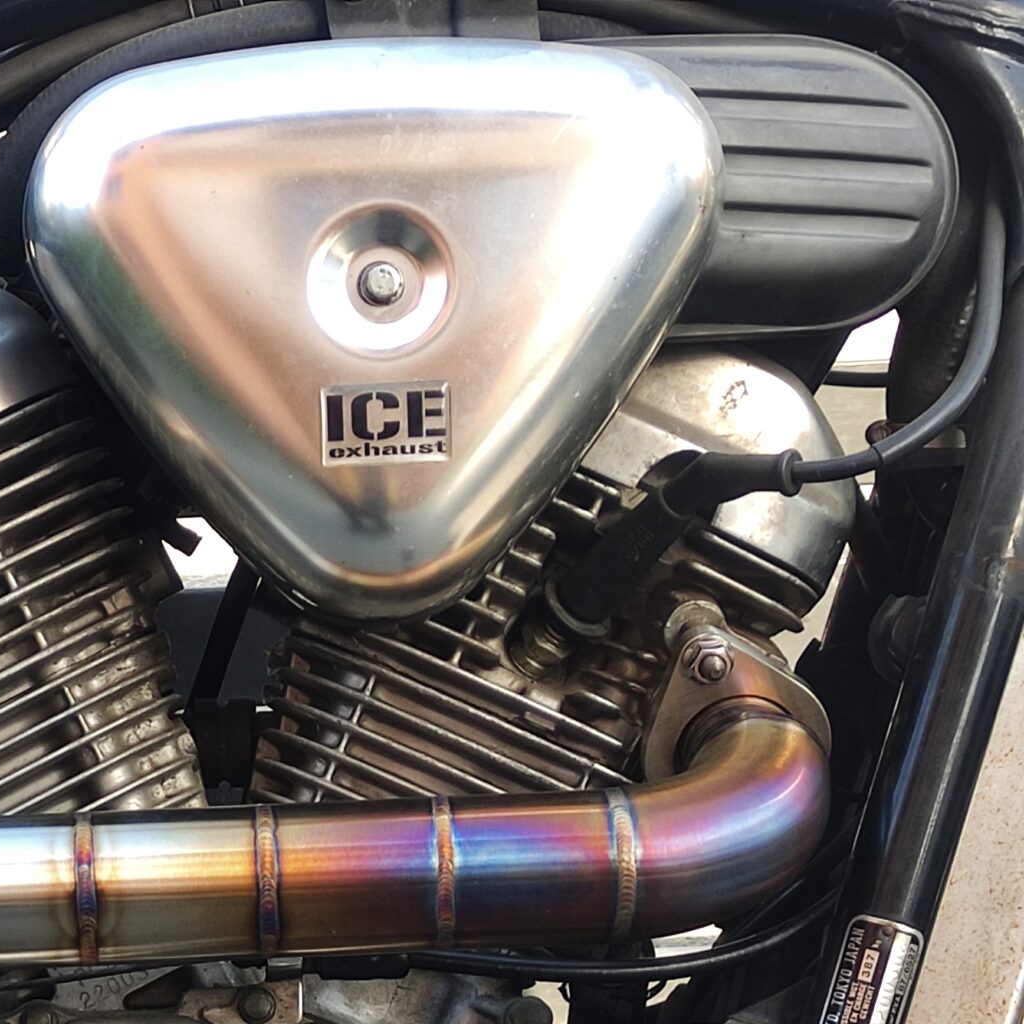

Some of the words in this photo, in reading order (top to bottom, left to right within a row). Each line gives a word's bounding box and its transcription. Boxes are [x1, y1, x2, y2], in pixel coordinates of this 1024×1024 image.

[326, 391, 446, 441] ICE
[329, 441, 446, 458] exhaust
[831, 968, 852, 1006] TOKYO
[844, 927, 863, 963] JAPAN
[861, 954, 874, 977] 387
